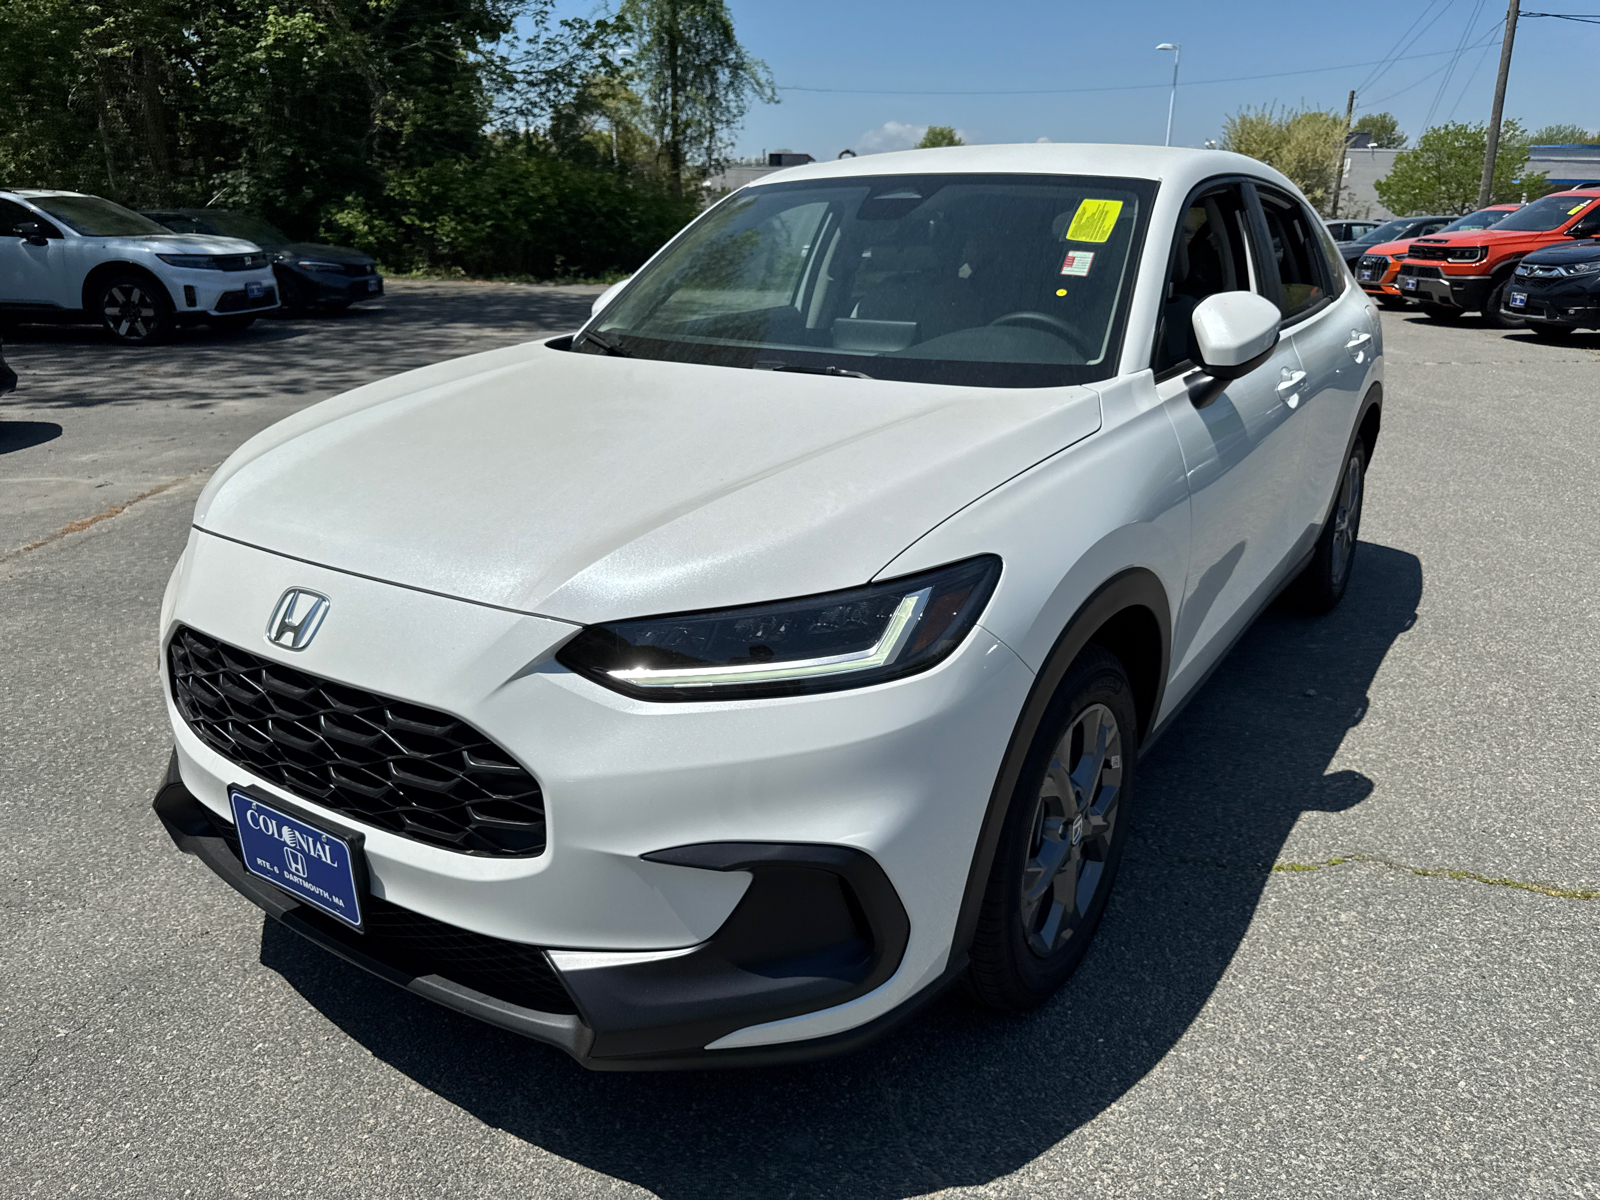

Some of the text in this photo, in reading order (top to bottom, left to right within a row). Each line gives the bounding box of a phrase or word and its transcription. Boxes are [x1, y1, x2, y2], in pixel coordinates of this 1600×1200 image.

[246, 809, 338, 868] COLONIAL
[273, 865, 280, 874] 6
[283, 870, 333, 902] DARTMOUTH,
[332, 895, 345, 908] MA
